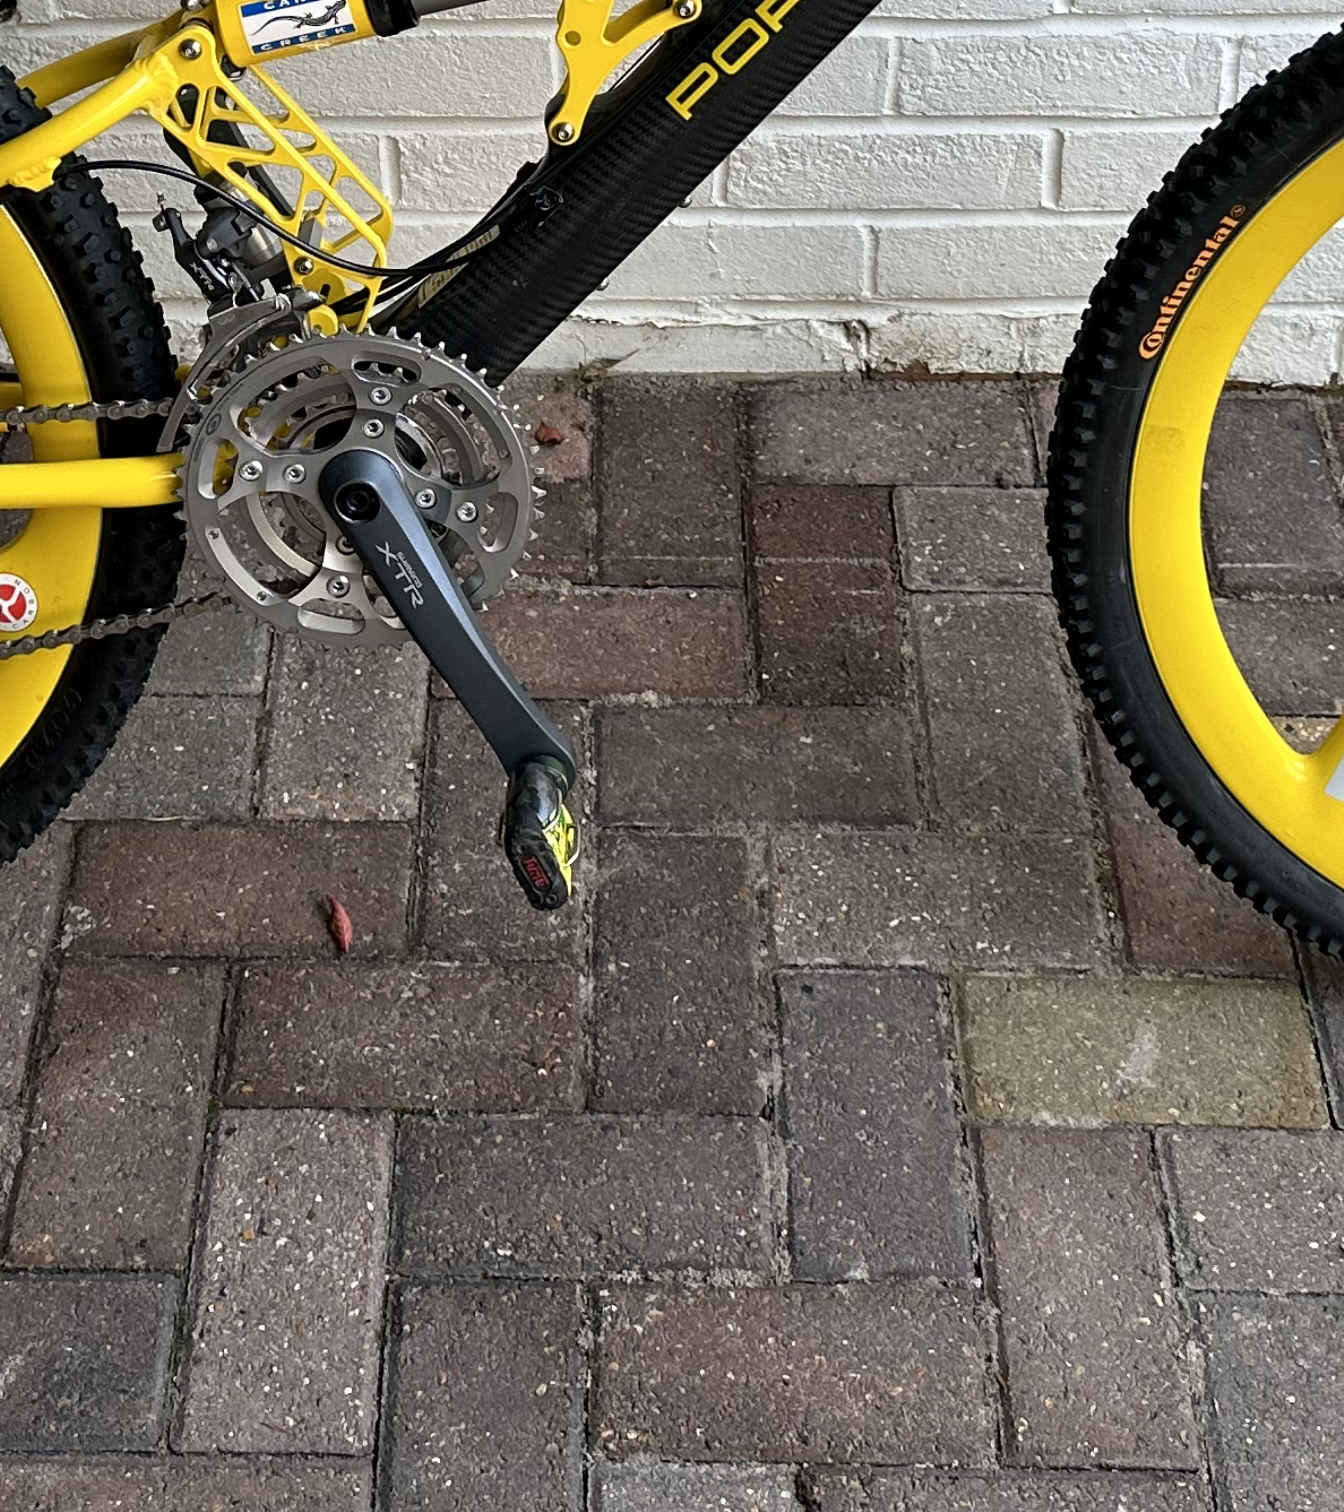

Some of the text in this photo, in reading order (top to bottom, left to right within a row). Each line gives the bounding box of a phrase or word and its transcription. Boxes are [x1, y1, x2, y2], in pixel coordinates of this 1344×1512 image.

[260, 25, 347, 51] CREEK
[1138, 208, 1240, 360] Continental
[374, 540, 425, 610] XTR
